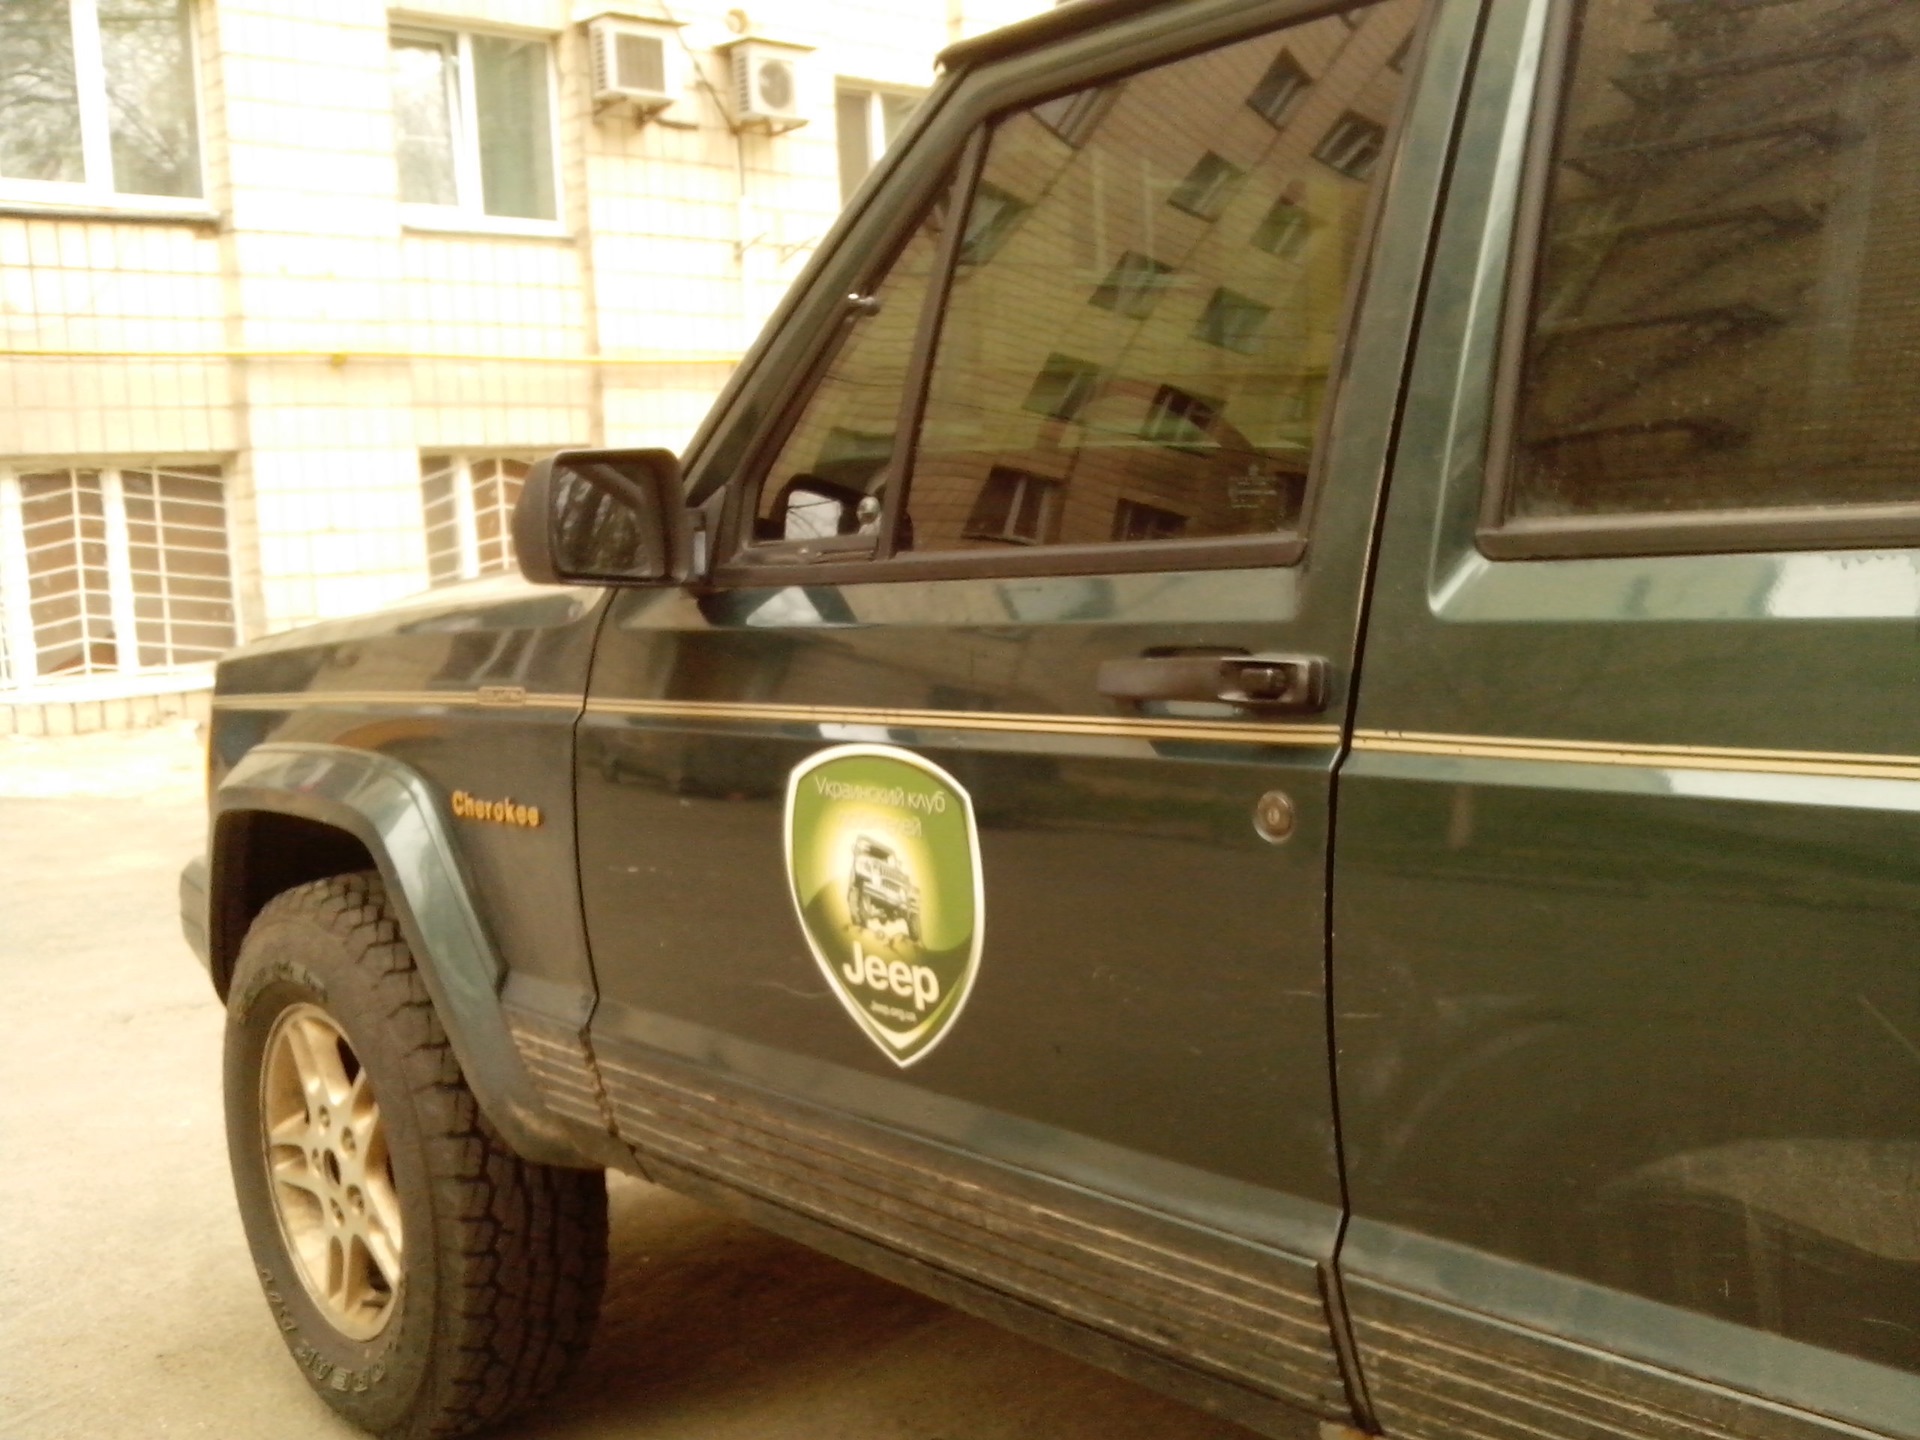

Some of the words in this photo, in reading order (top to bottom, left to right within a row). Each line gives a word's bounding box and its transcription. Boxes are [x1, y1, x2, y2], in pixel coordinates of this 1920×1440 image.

[452, 790, 539, 827] Cherokee
[908, 790, 946, 815] клуб
[842, 940, 940, 1011] Jeep
